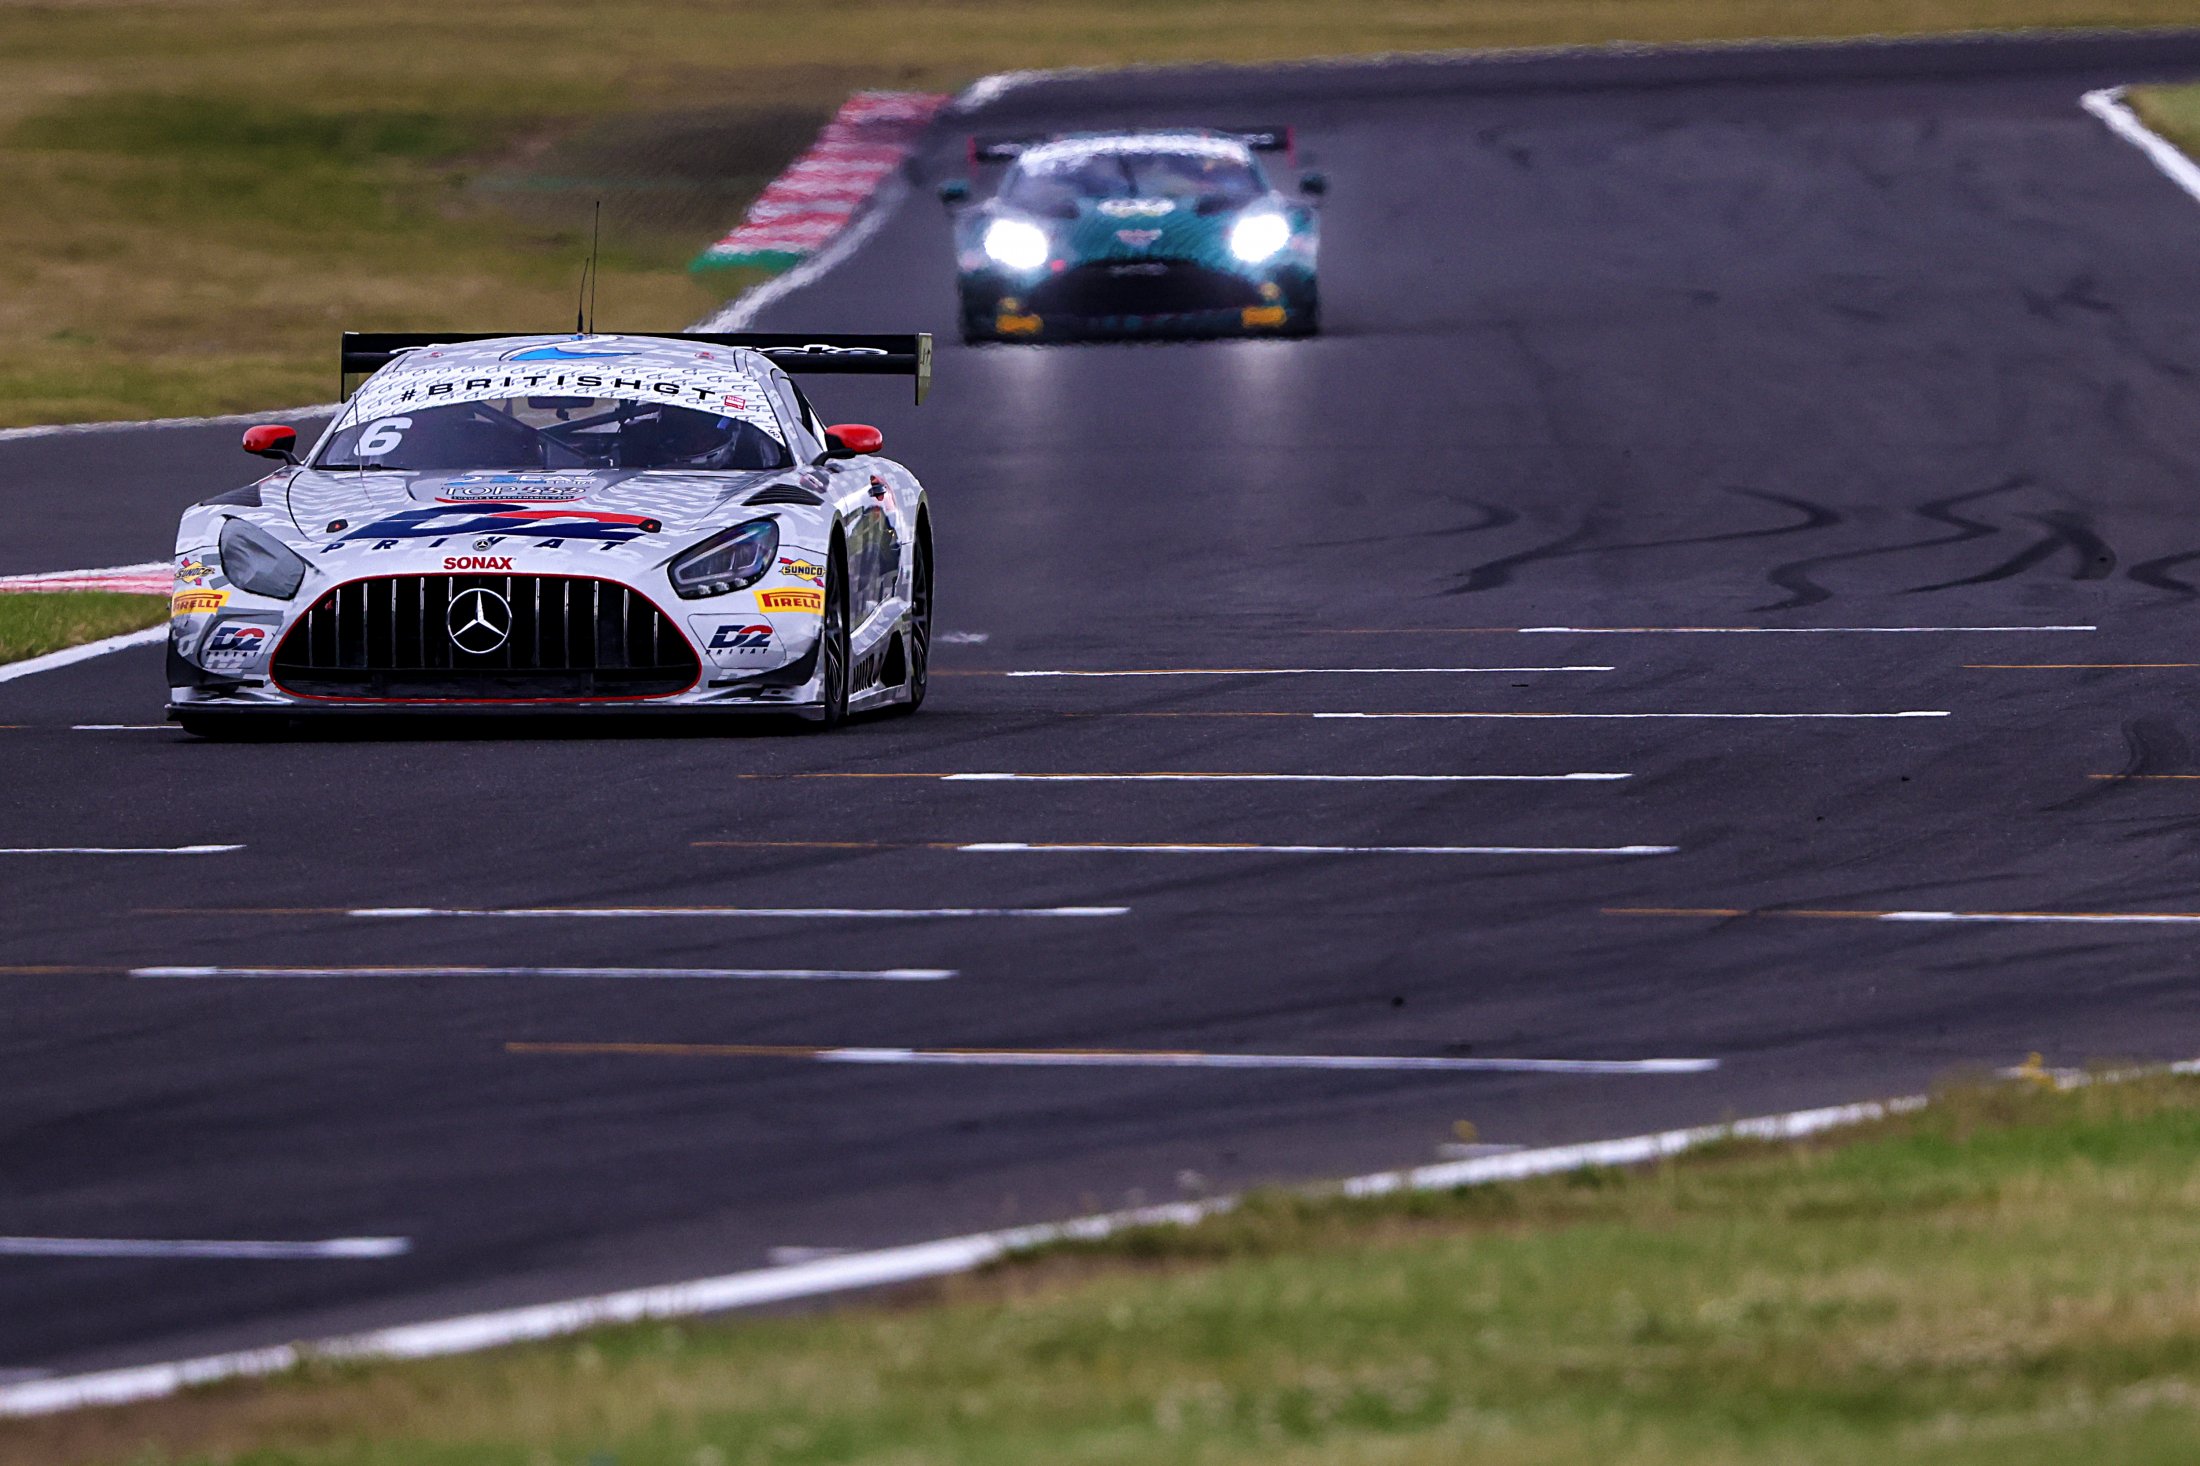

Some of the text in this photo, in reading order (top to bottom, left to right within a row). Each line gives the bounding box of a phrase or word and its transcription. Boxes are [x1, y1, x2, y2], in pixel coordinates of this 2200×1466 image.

[400, 375, 716, 403] #BRITISHGT
[353, 417, 413, 456] 6
[441, 486, 518, 496] TOP
[320, 536, 626, 554] PRIVAT
[443, 556, 513, 570] SONAX
[784, 565, 823, 576] SUNOCO
[761, 591, 821, 609] PIRELLI
[208, 626, 265, 651] D2
[708, 624, 774, 649] D2
[705, 647, 768, 655] PRIVAT
